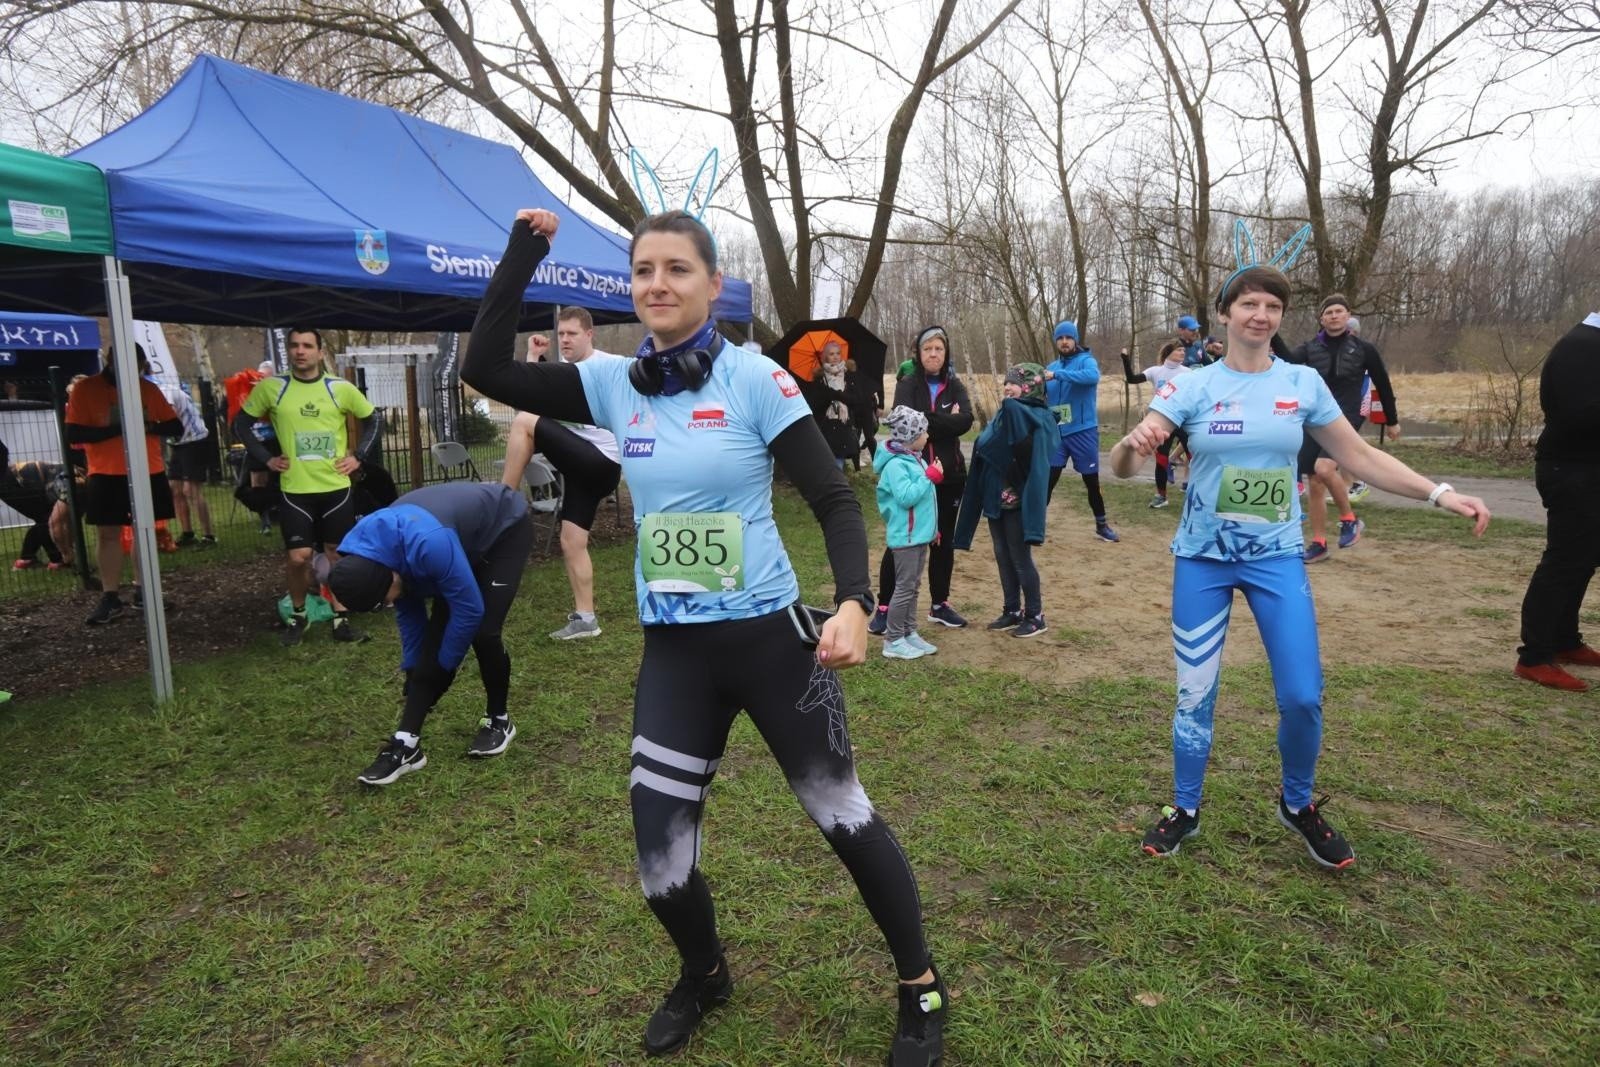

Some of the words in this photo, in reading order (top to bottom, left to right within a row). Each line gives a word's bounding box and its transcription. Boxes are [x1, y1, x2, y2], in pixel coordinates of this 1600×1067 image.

[426, 244, 578, 288] Siemiwice
[688, 421, 728, 429] POLAND
[1216, 423, 1241, 431] JYSK
[301, 436, 330, 450] 327
[628, 443, 653, 453] JYSK
[1229, 479, 1285, 505] 326
[650, 529, 727, 566] 385
